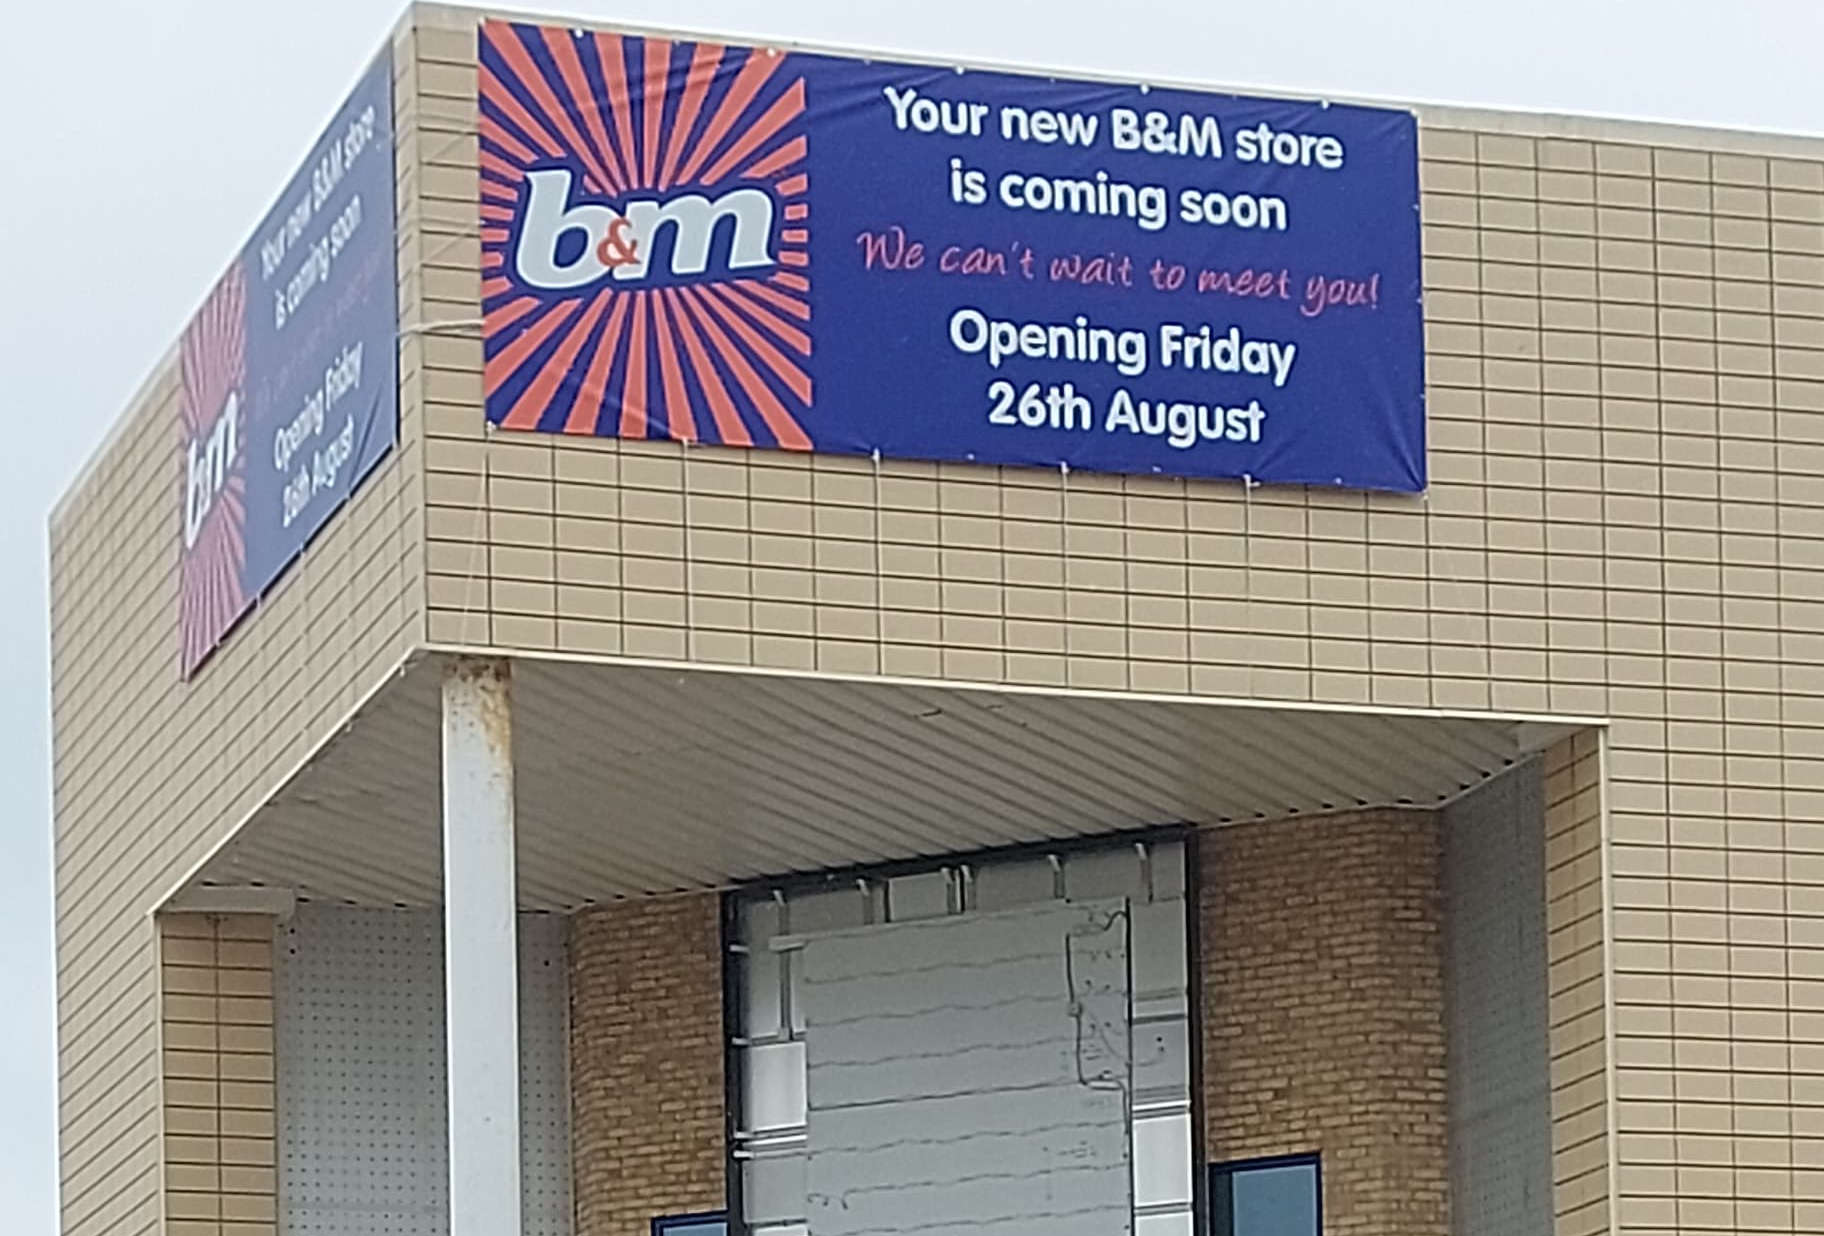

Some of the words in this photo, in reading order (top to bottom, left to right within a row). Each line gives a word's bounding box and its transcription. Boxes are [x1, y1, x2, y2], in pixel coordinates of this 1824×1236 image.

[883, 86, 989, 136] Your
[1001, 107, 1098, 146] new
[1112, 108, 1223, 158] B&M
[1236, 123, 1343, 168] store
[516, 168, 776, 289] b&m
[951, 158, 987, 204] is
[1000, 171, 1167, 230] coming
[1180, 190, 1287, 230] soon
[857, 226, 924, 270] We
[940, 241, 1034, 279] can't
[1050, 253, 1132, 287] wait
[1150, 259, 1185, 290] to
[1198, 269, 1290, 299] meet
[1300, 273, 1379, 317] you!
[951, 310, 1146, 376] Opening
[1161, 325, 1296, 386] Friday
[989, 381, 1091, 430] 26th
[1105, 390, 1265, 448] August
